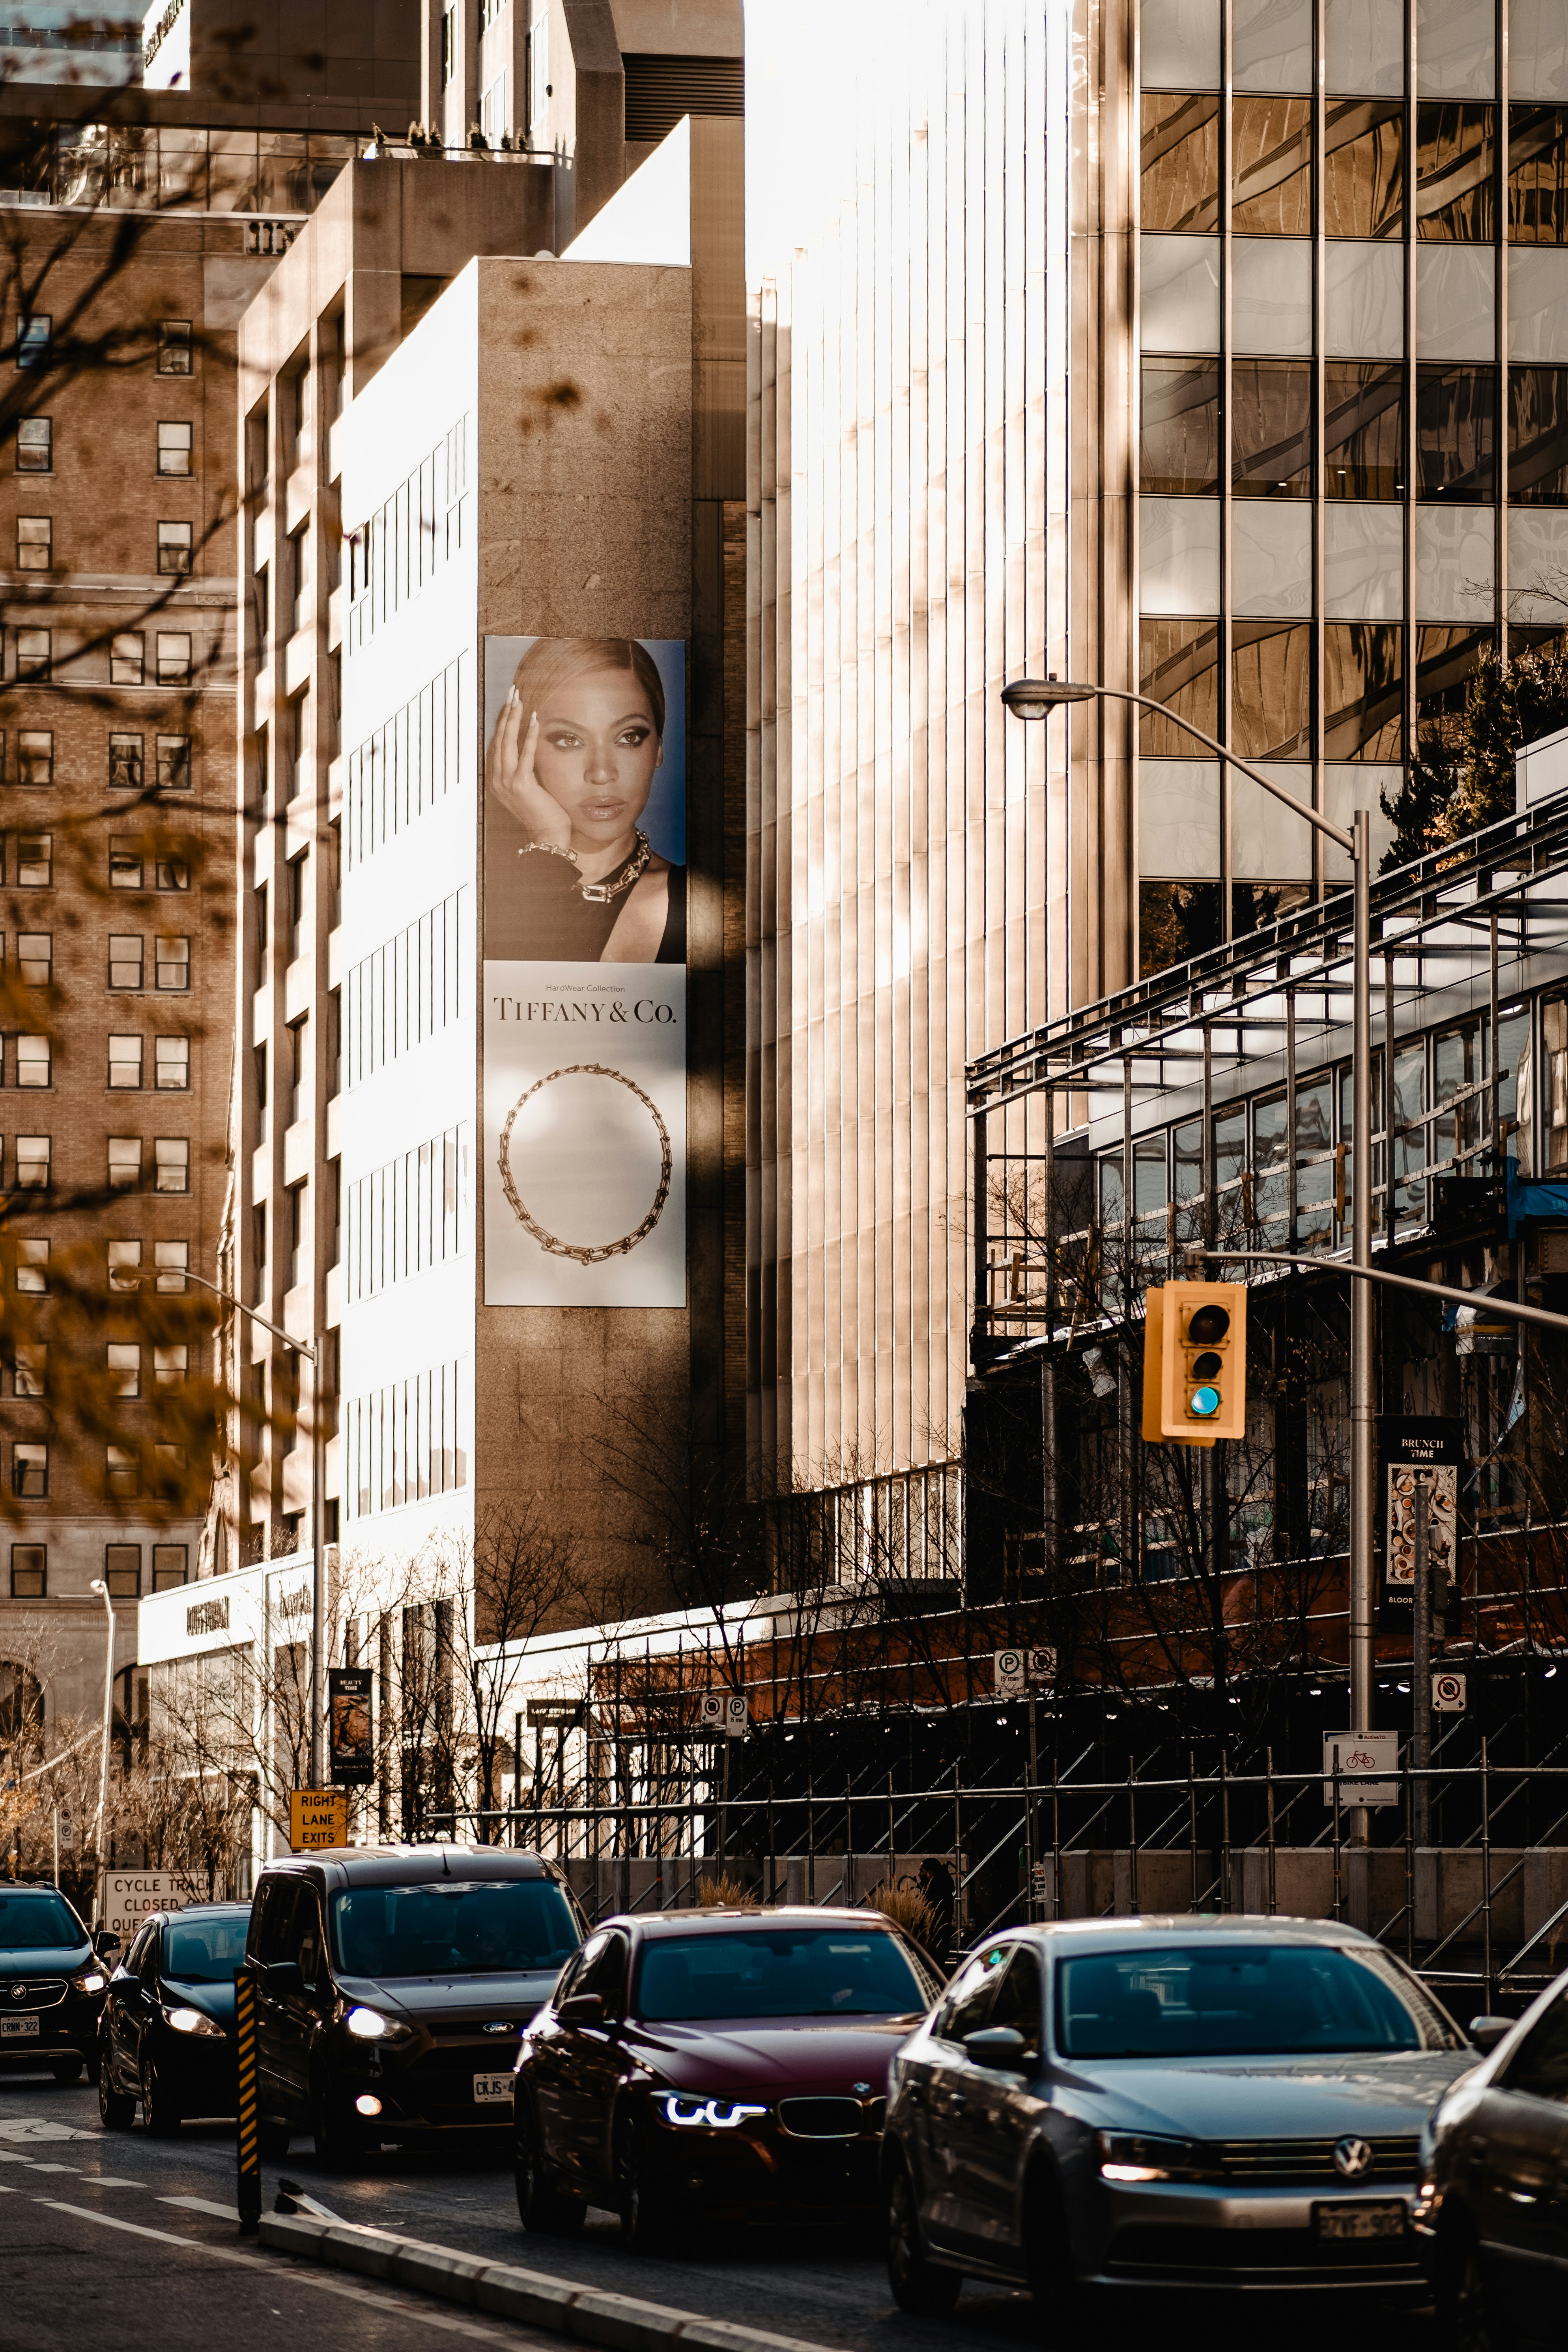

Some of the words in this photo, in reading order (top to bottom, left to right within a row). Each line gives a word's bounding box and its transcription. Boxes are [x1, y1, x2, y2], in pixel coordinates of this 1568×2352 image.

[494, 997, 606, 1022] TIFFANY
[609, 1001, 630, 1022] &
[1402, 1439, 1443, 1448] BRUNCH
[1411, 1449, 1434, 1458] TIME
[301, 1796, 335, 1807] RIGHT
[303, 1814, 335, 1825] LANE
[303, 1832, 335, 1843] EXITS
[114, 1879, 161, 1892] CYCLE
[124, 1898, 179, 1912] CLOSED
[2, 2022, 20, 2032] CRNN
[24, 2021, 38, 2031] 322
[476, 2081, 502, 2096] CKJS
